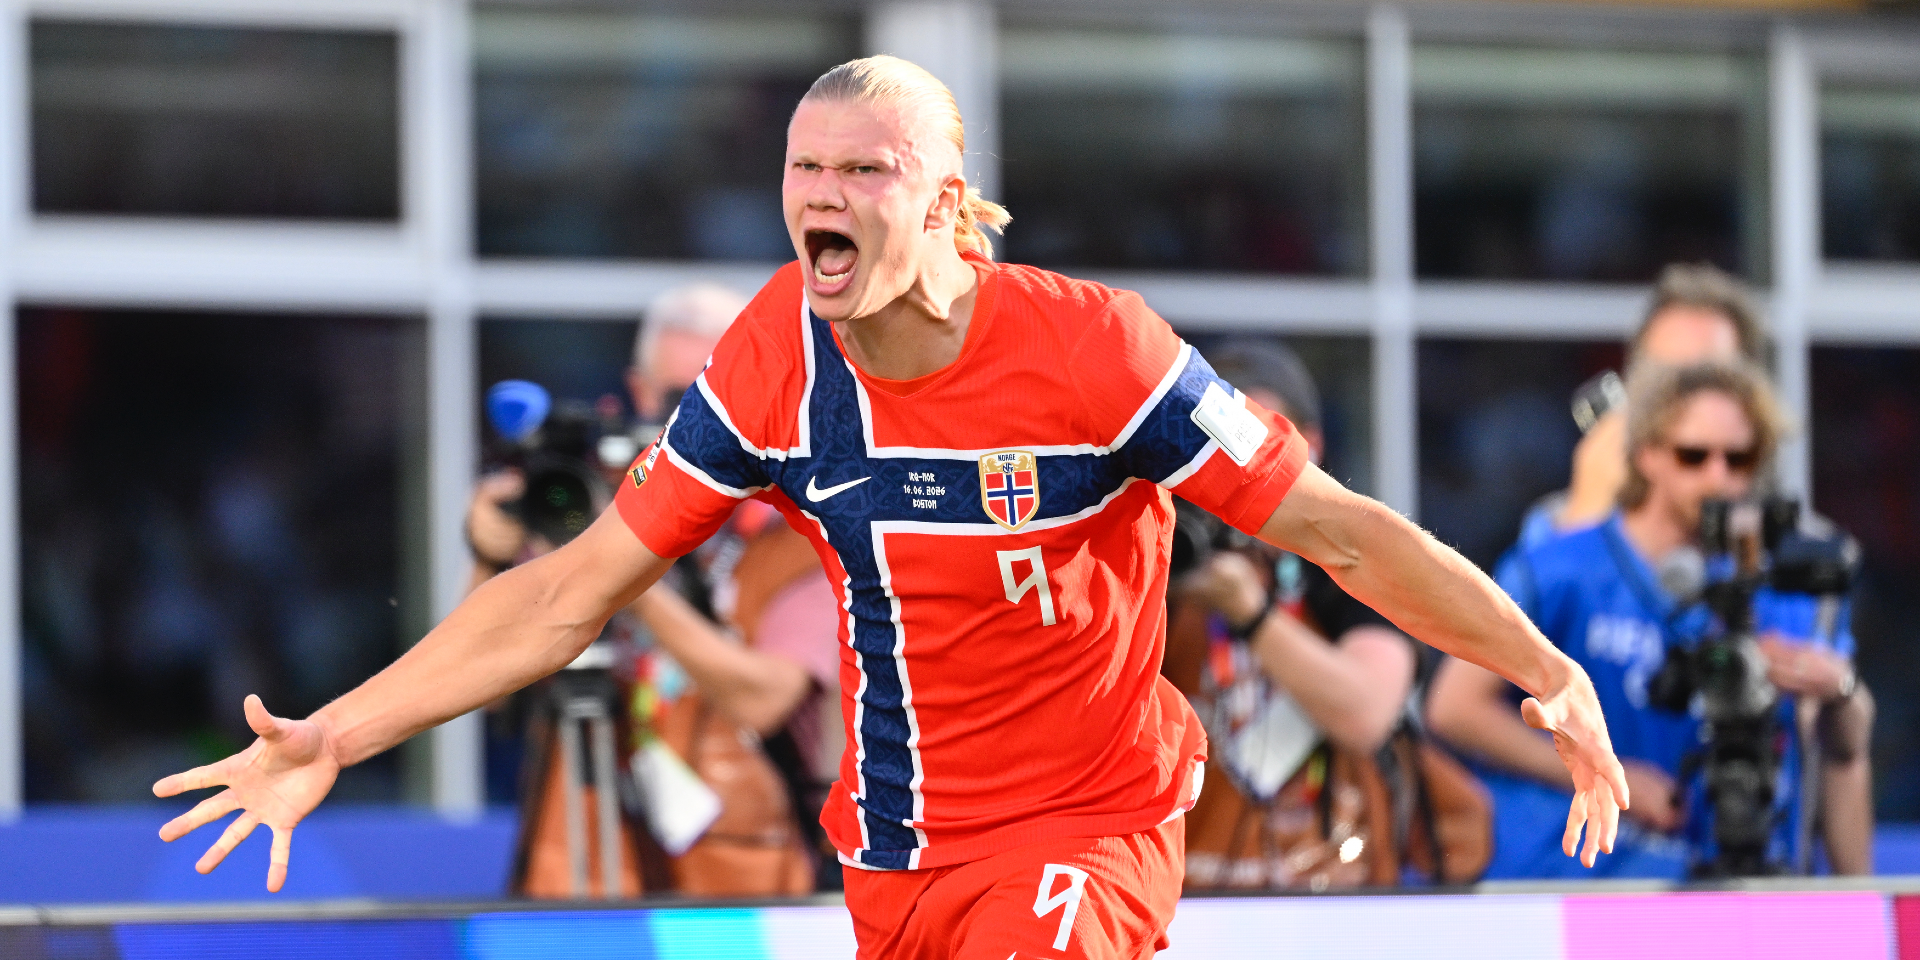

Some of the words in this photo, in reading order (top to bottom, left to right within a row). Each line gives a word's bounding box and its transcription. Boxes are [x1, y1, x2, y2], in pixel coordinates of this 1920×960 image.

[913, 499, 936, 509] BOSTON
[996, 545, 1056, 626] 9
[1033, 864, 1089, 951] 9
